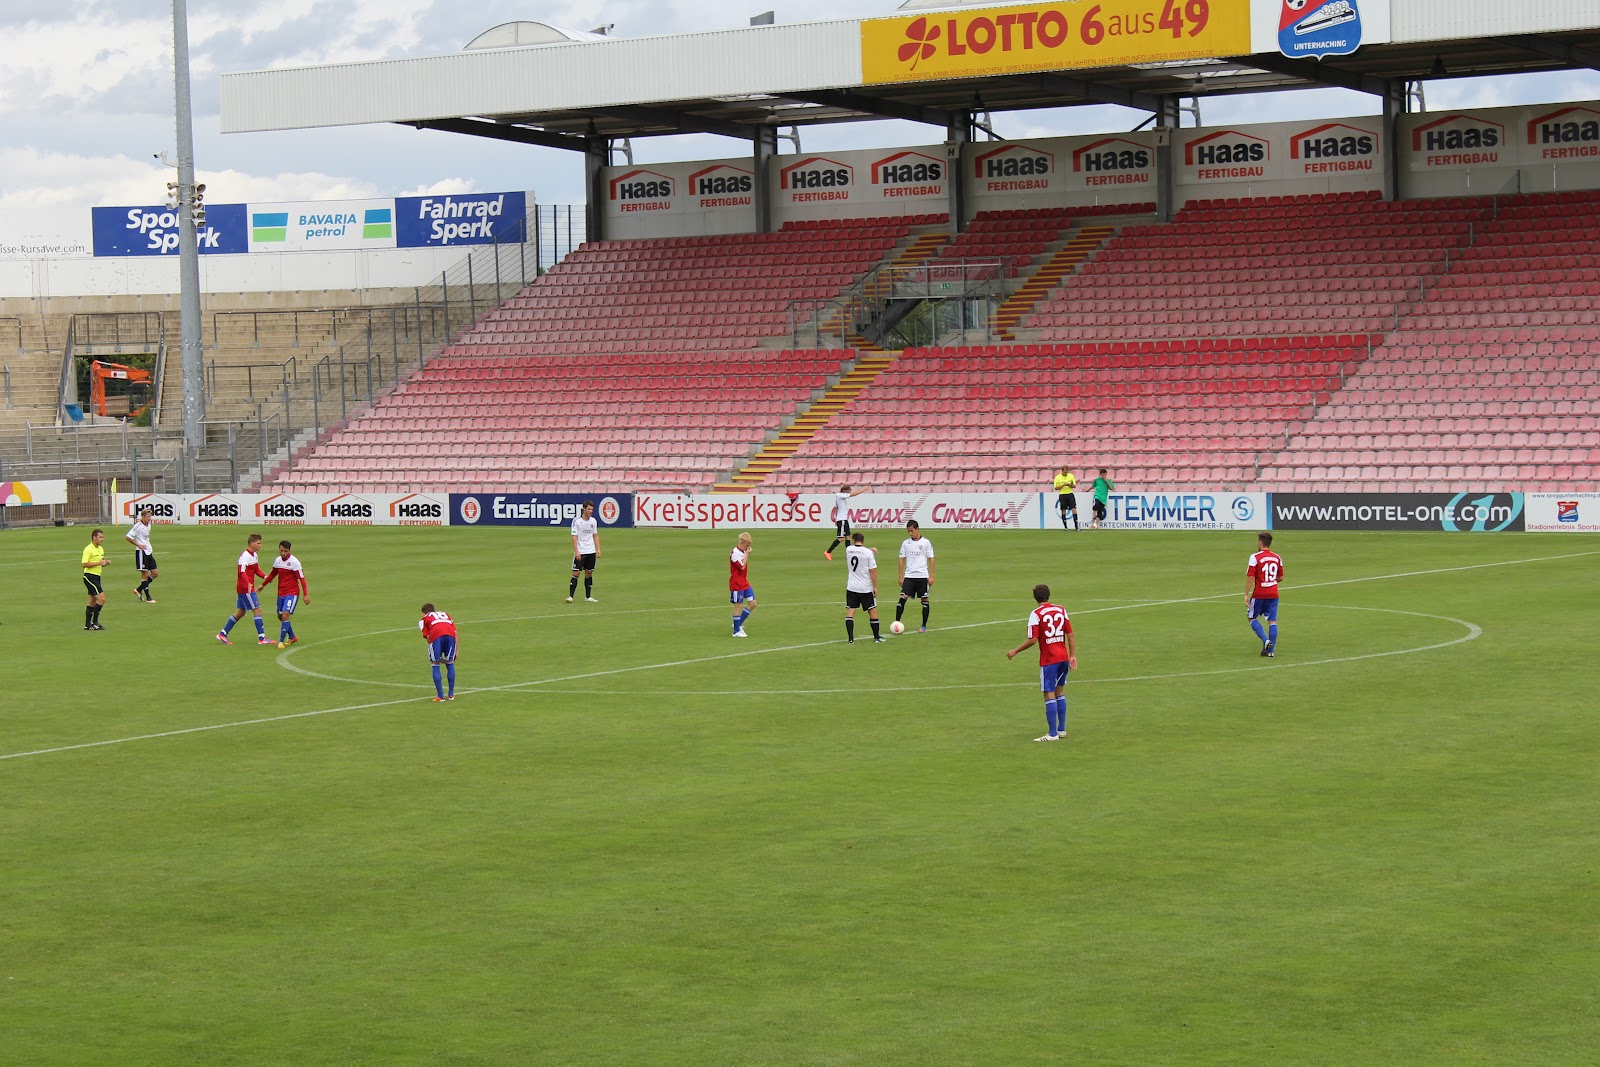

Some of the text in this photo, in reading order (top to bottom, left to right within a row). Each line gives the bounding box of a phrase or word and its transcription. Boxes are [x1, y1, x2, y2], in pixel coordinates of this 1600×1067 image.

[947, 10, 1069, 56] LOTTO
[1294, 40, 1347, 50] UNTERHACHING
[894, 72, 932, 80] GLÜCKSSPIEL
[950, 68, 975, 76] SÜCHTIG
[1005, 62, 1055, 72] SPIELTEILNAHME
[1099, 56, 1116, 64] HILFE
[1147, 53, 1169, 61] UNTER
[1169, 49, 1215, 59] WWW.BZGA.DE
[1426, 128, 1499, 151] Haas
[1542, 120, 1600, 143] Haa
[1198, 143, 1264, 165] Haas
[1304, 135, 1373, 158] Haas
[987, 156, 1049, 177] Haas
[1085, 150, 1149, 172] Haas
[1304, 159, 1373, 174] FERTIGBAU
[1427, 152, 1498, 166] FERTIGBAU
[792, 169, 849, 189] Haas
[883, 163, 941, 184] Haas
[1086, 173, 1149, 186] FERTIGBAU
[1198, 166, 1264, 180] FERTIGBAU
[620, 180, 671, 199] Haas
[700, 175, 752, 195] Haas
[883, 185, 941, 197] FERTIGBAU
[987, 179, 1048, 191] FERTIGBAU
[620, 201, 671, 212] FERTIGBAU
[700, 197, 751, 208] FERTIGBAU
[792, 190, 849, 203] FERTIGBAU
[419, 194, 504, 220] Fahrrad
[126, 208, 180, 234] Spo
[299, 213, 357, 226] BAVARIA
[147, 226, 221, 254] Sprk
[305, 225, 346, 240] petrol
[430, 217, 494, 245] Sperk
[198, 503, 239, 517] Haas
[264, 503, 305, 517] Haas
[330, 503, 372, 517] Haas
[398, 503, 442, 517] Haas
[492, 496, 583, 525] Ensinger
[636, 495, 822, 529] Kreissparkasse
[850, 556, 859, 572] 9
[1261, 562, 1278, 582] 19
[1042, 612, 1065, 638] 32
